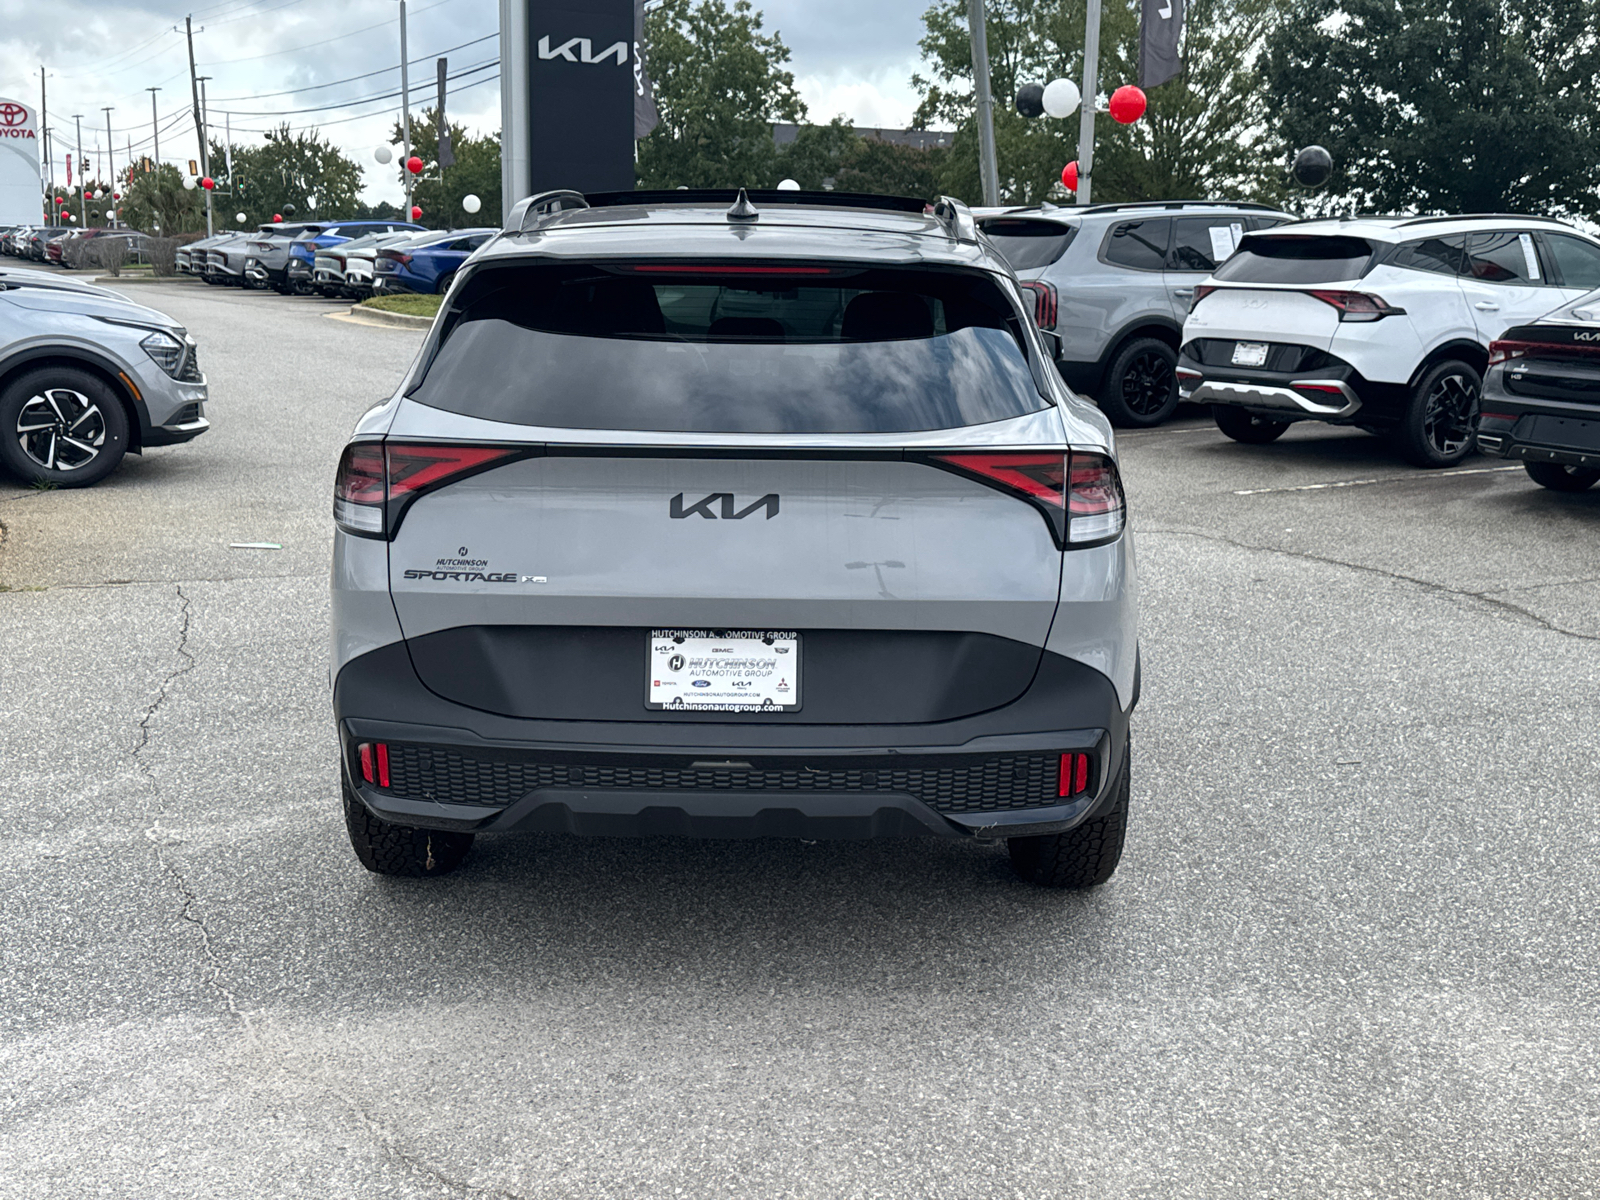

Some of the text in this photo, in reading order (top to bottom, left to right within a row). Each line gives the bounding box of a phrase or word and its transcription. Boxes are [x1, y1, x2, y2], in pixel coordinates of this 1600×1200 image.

[538, 34, 628, 66] KIA
[0, 128, 36, 139] YOTA
[669, 492, 780, 520] KIA
[435, 558, 489, 567] HUTCHINSON
[403, 569, 518, 583] SPORTAGE
[651, 630, 798, 640] HUTCHINSON AOMOTIVE GROUP
[687, 657, 778, 670] HUTCHINSON
[689, 669, 743, 677] AUTOMOTIVE
[662, 702, 784, 713] Hutchinsonautogroup.com
